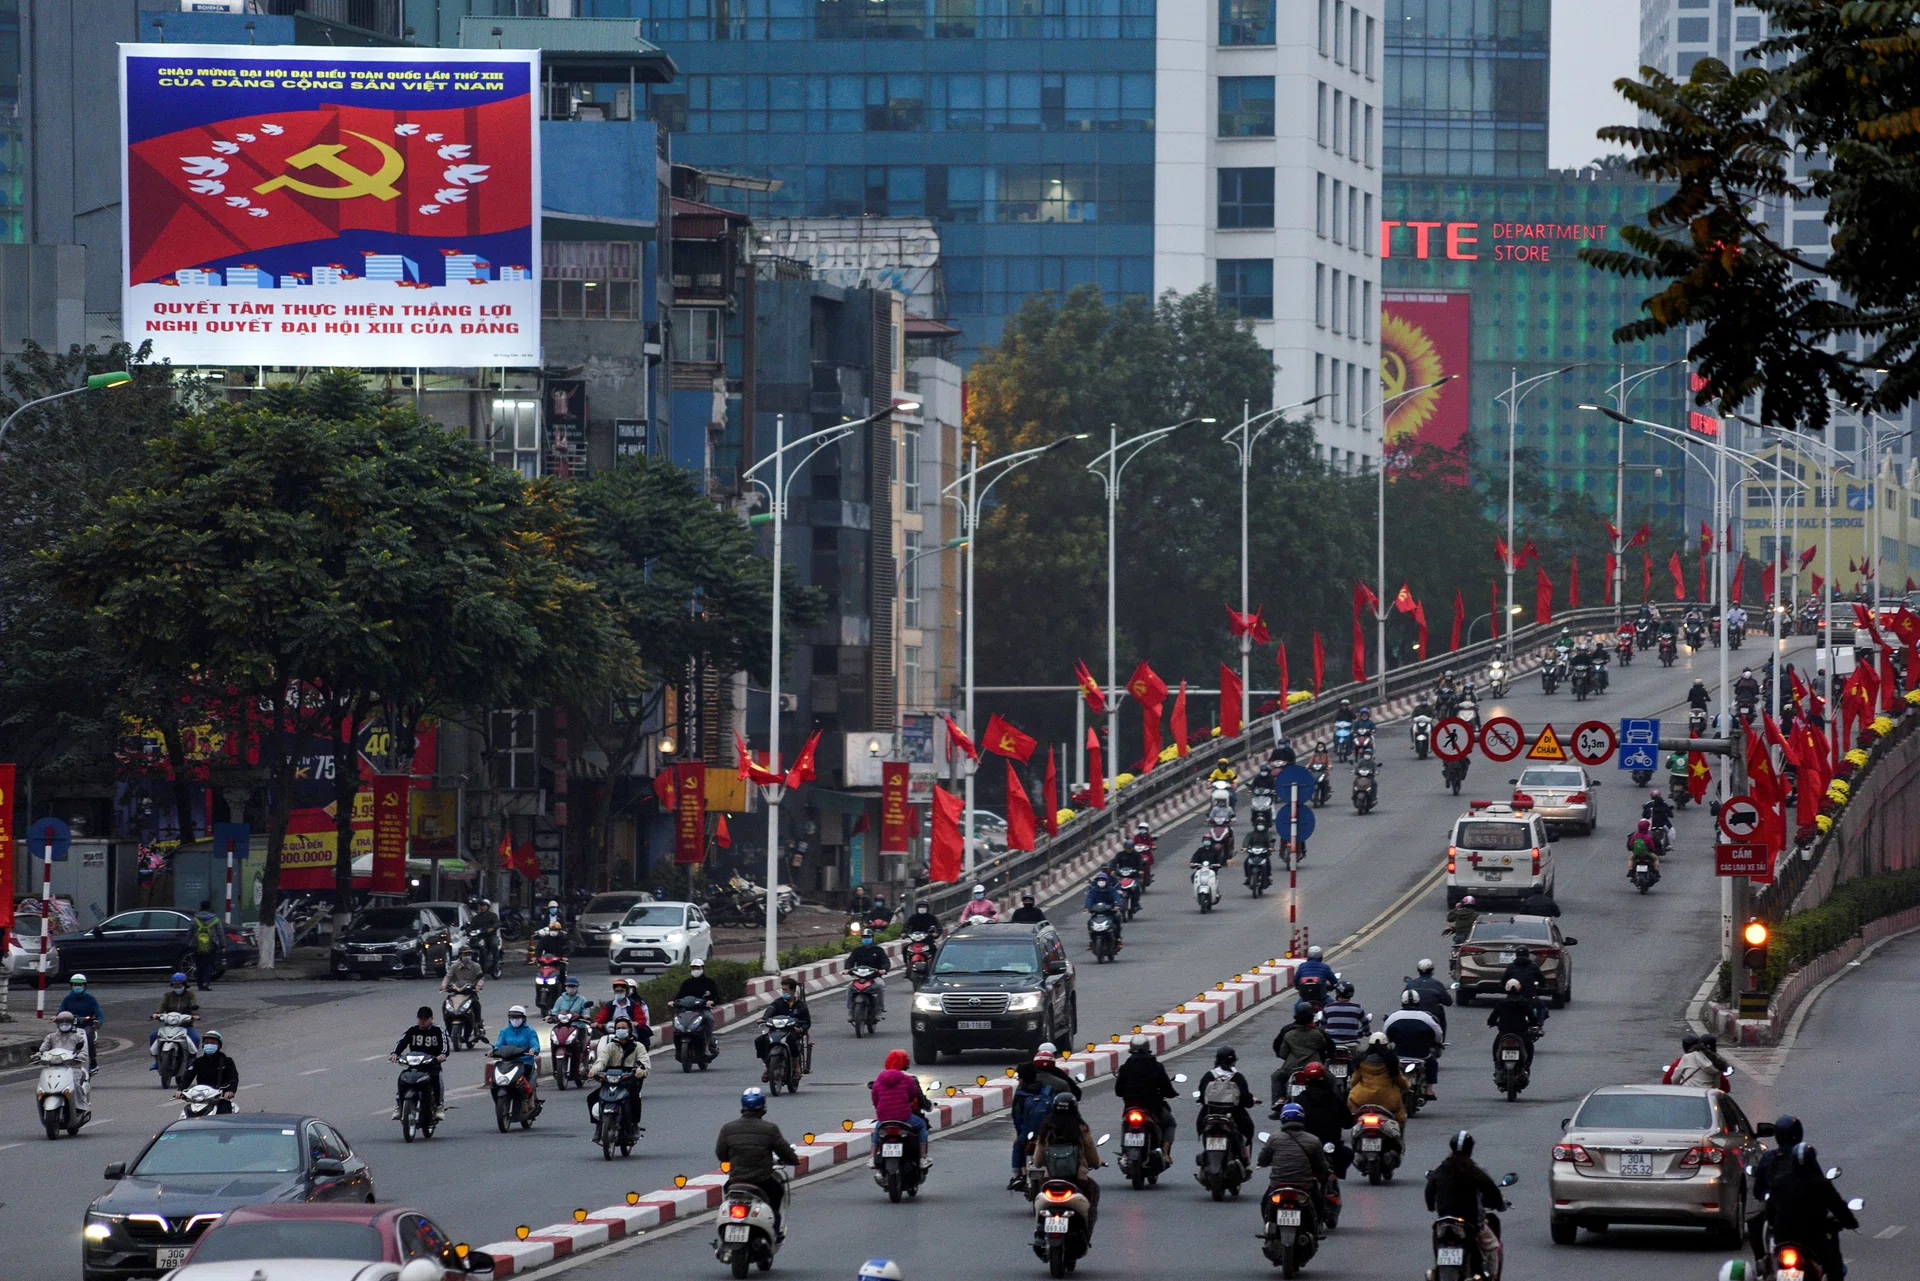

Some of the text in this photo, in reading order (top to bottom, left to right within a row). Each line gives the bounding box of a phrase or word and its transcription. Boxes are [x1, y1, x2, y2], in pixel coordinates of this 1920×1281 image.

[158, 67, 194, 76] CHÀO
[197, 67, 237, 77] MỪNG
[240, 69, 262, 79] ĐẠI
[266, 69, 287, 79] HỘI
[291, 70, 313, 80] ĐẠI
[316, 69, 346, 79] BIỂU
[350, 70, 384, 80] TOÀN
[387, 70, 422, 80] QUỐC
[454, 71, 479, 80] THỨ
[481, 72, 504, 80] XIII
[158, 75, 504, 92] CỦA ĐẢNG CỘNG SẢN VIỆT NAM
[1492, 223, 1607, 240] DEPARTMENT
[1494, 245, 1550, 262] STORE
[153, 299, 221, 315] QUYẾT
[228, 301, 274, 315] TÂM
[281, 303, 337, 318] THỰC
[344, 302, 394, 319] HIỆN
[480, 303, 512, 319] LỢI
[146, 317, 520, 336] NGHỊ QUYẾT ĐẠI HỘI XIII CỦA ĐẢNG
[1581, 734, 1605, 752] 3,3m
[1731, 846, 1753, 859] CẤM
[1747, 863, 1756, 871] XE
[411, 1034, 439, 1047] 1998
[1627, 1154, 1645, 1165] 30A
[1621, 1164, 1651, 1175] 255.32
[168, 1249, 185, 1259] 30G
